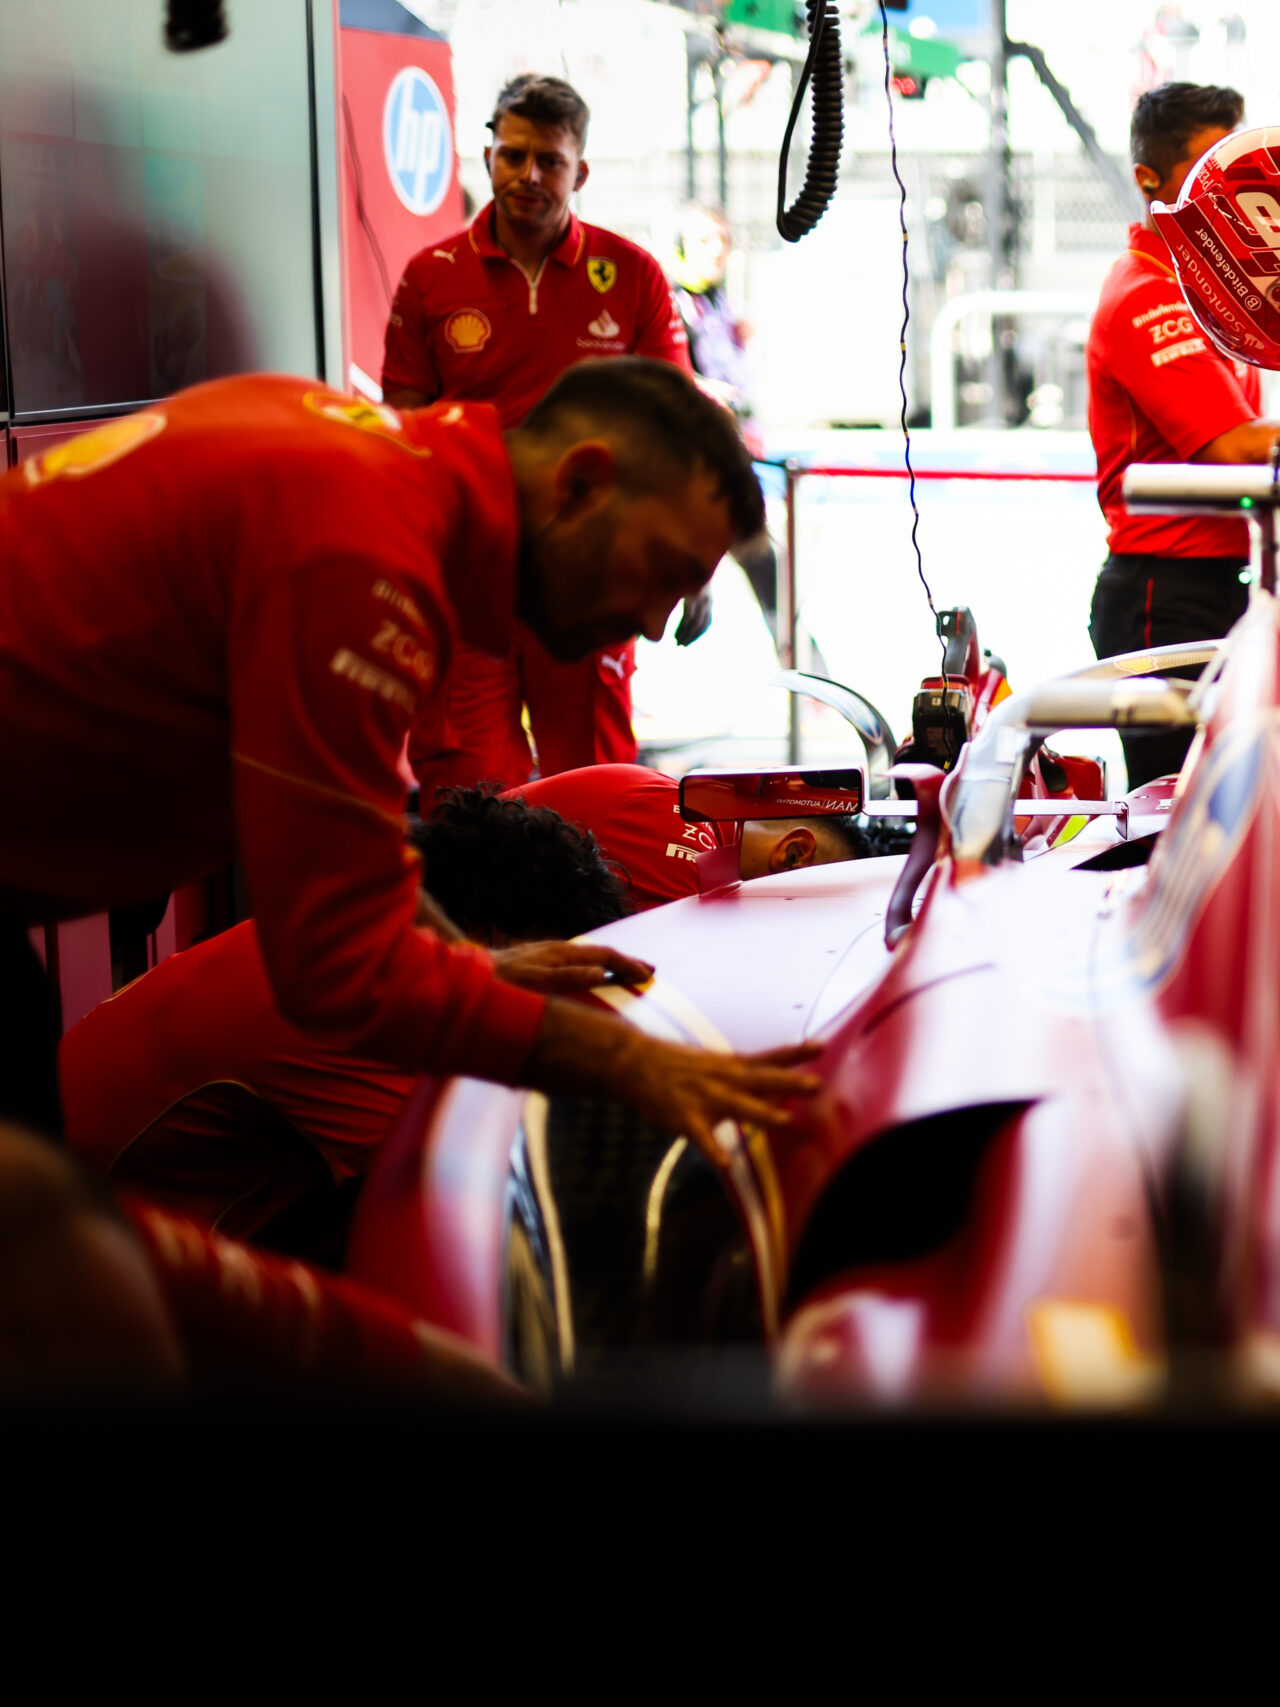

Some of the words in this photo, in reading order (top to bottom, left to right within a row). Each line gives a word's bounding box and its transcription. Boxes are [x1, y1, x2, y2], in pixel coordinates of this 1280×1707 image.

[393, 71, 446, 210] hp
[1176, 244, 1246, 333] Santander
[1195, 228, 1249, 297] Bitdefender
[1148, 316, 1194, 345] ZCG
[682, 823, 717, 851] ZC
